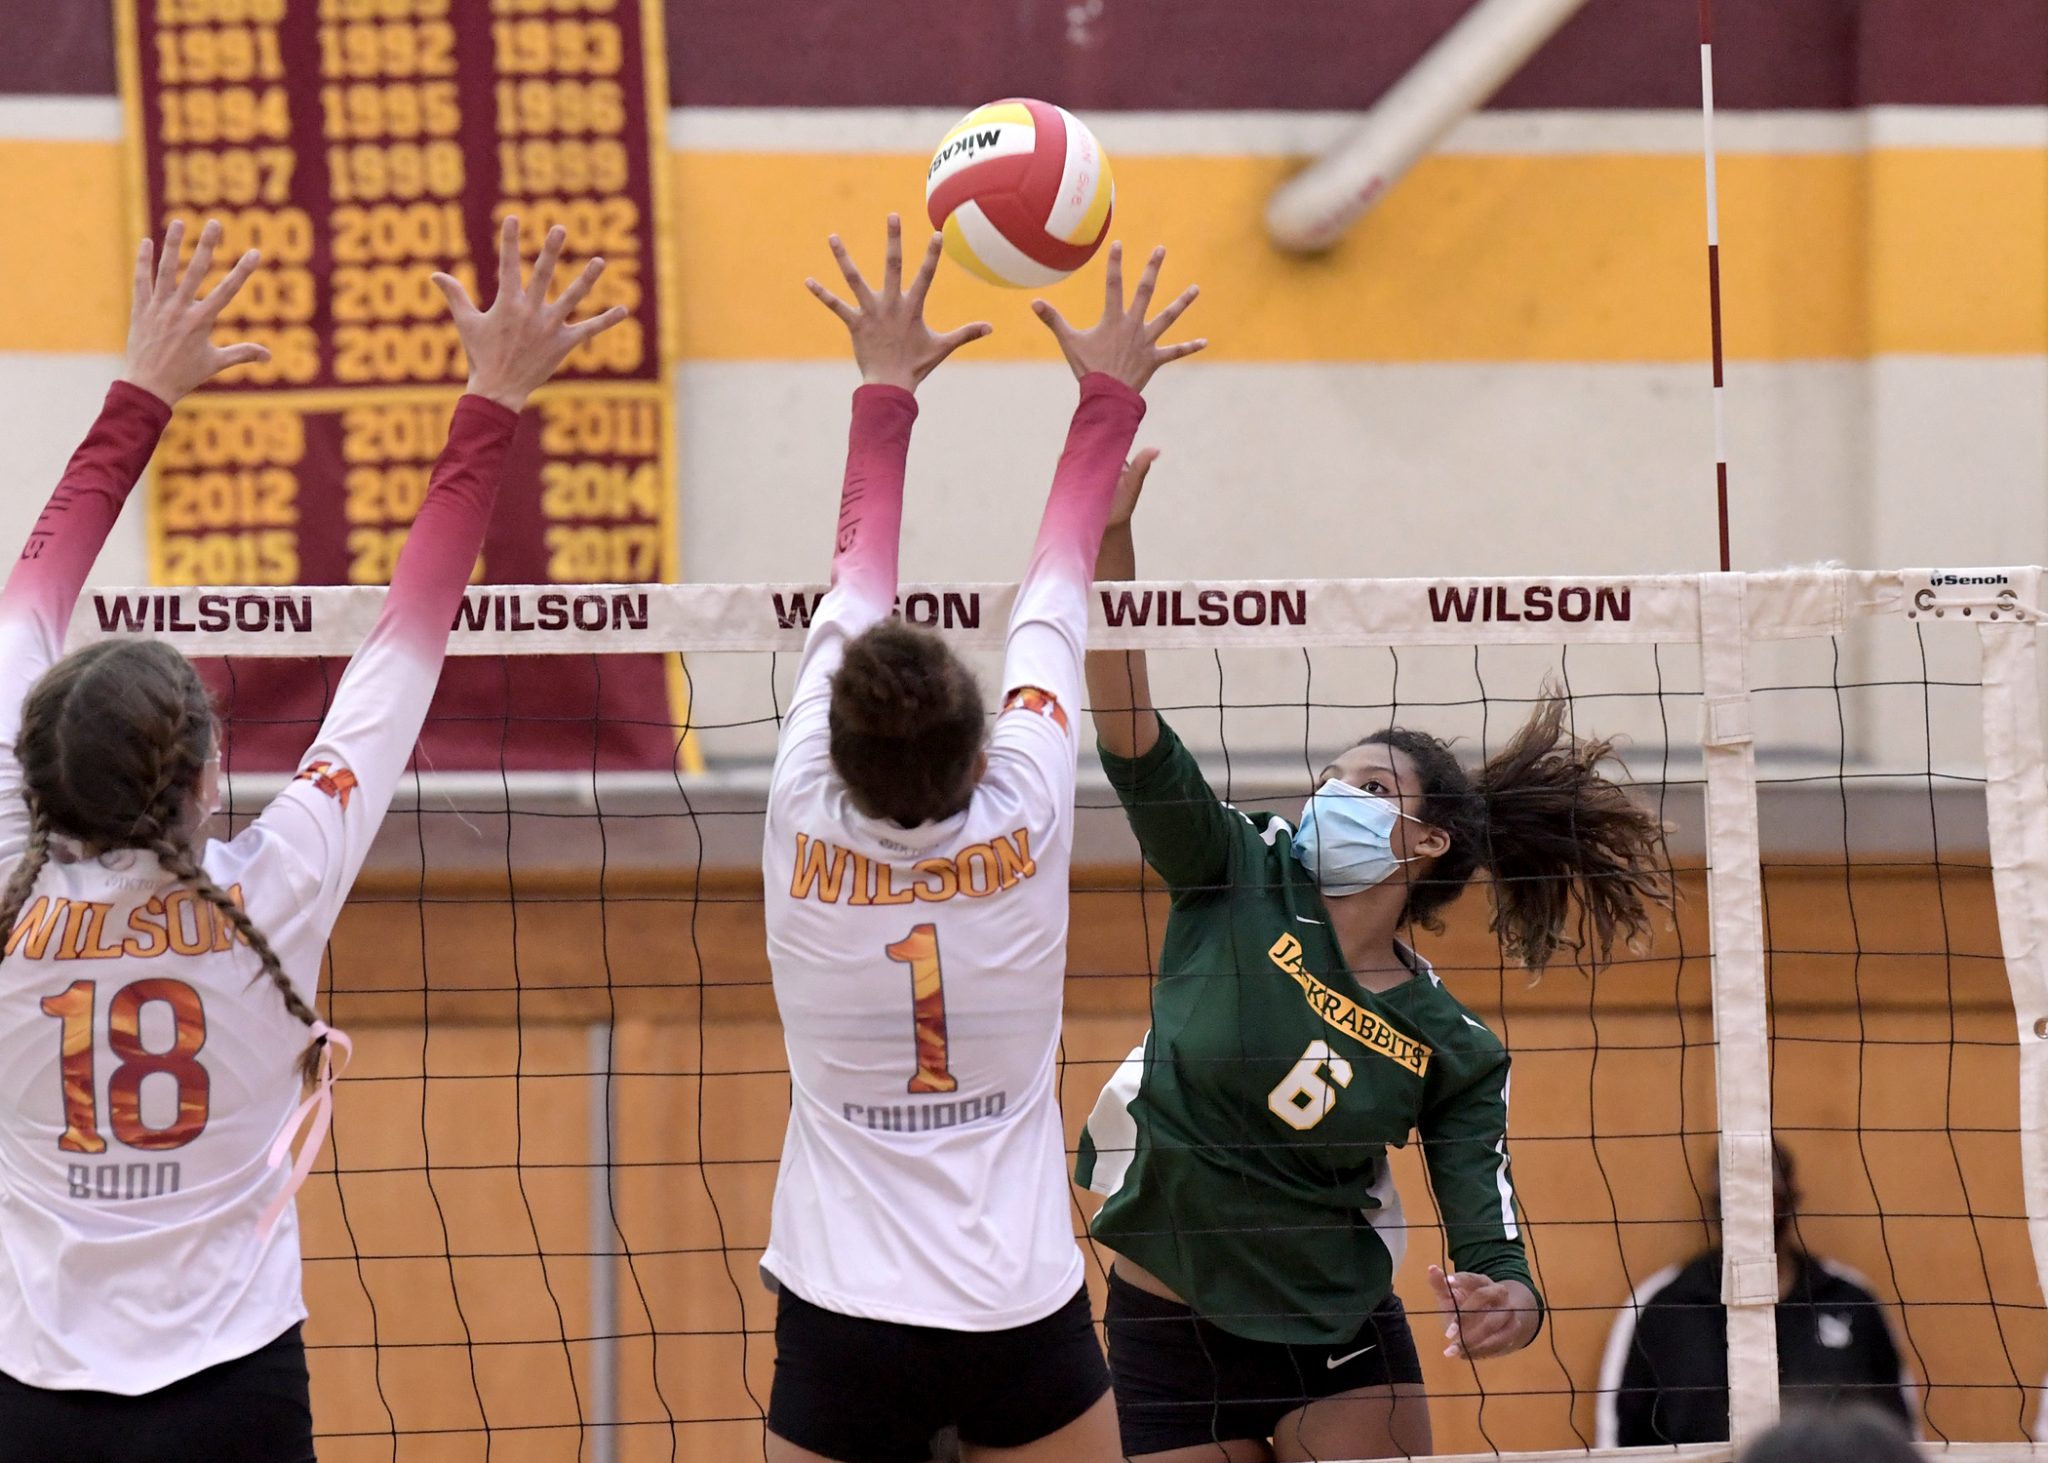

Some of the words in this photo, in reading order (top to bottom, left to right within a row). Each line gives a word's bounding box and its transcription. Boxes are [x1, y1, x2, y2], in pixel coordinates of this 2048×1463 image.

[156, 27, 284, 84] 1991
[318, 21, 459, 78] 1992
[493, 18, 623, 75] 1993
[159, 85, 291, 144] 1994
[320, 81, 461, 139] 1995
[495, 79, 626, 135] 1996
[163, 146, 295, 202] 1997
[326, 141, 466, 199] 1998
[498, 138, 629, 196] 1999
[329, 204, 469, 262] 2001
[162, 406, 305, 466] 2009
[541, 396, 658, 455] 2011
[162, 467, 299, 526] 2012
[540, 460, 659, 520] 2014
[164, 530, 299, 586] 2015
[543, 522, 658, 584] 2017
[1944, 574, 2008, 585] Senoh
[93, 594, 312, 633] WILSON
[450, 593, 649, 631] WILSON
[771, 592, 980, 630] WON
[1101, 589, 1306, 627] WILSON
[1428, 586, 1631, 622] WILSON
[789, 827, 1037, 906] WILSON
[3, 882, 250, 961] WILSON
[884, 922, 958, 1094] 1
[39, 977, 210, 1154] 18
[1267, 1039, 1354, 1131] 6
